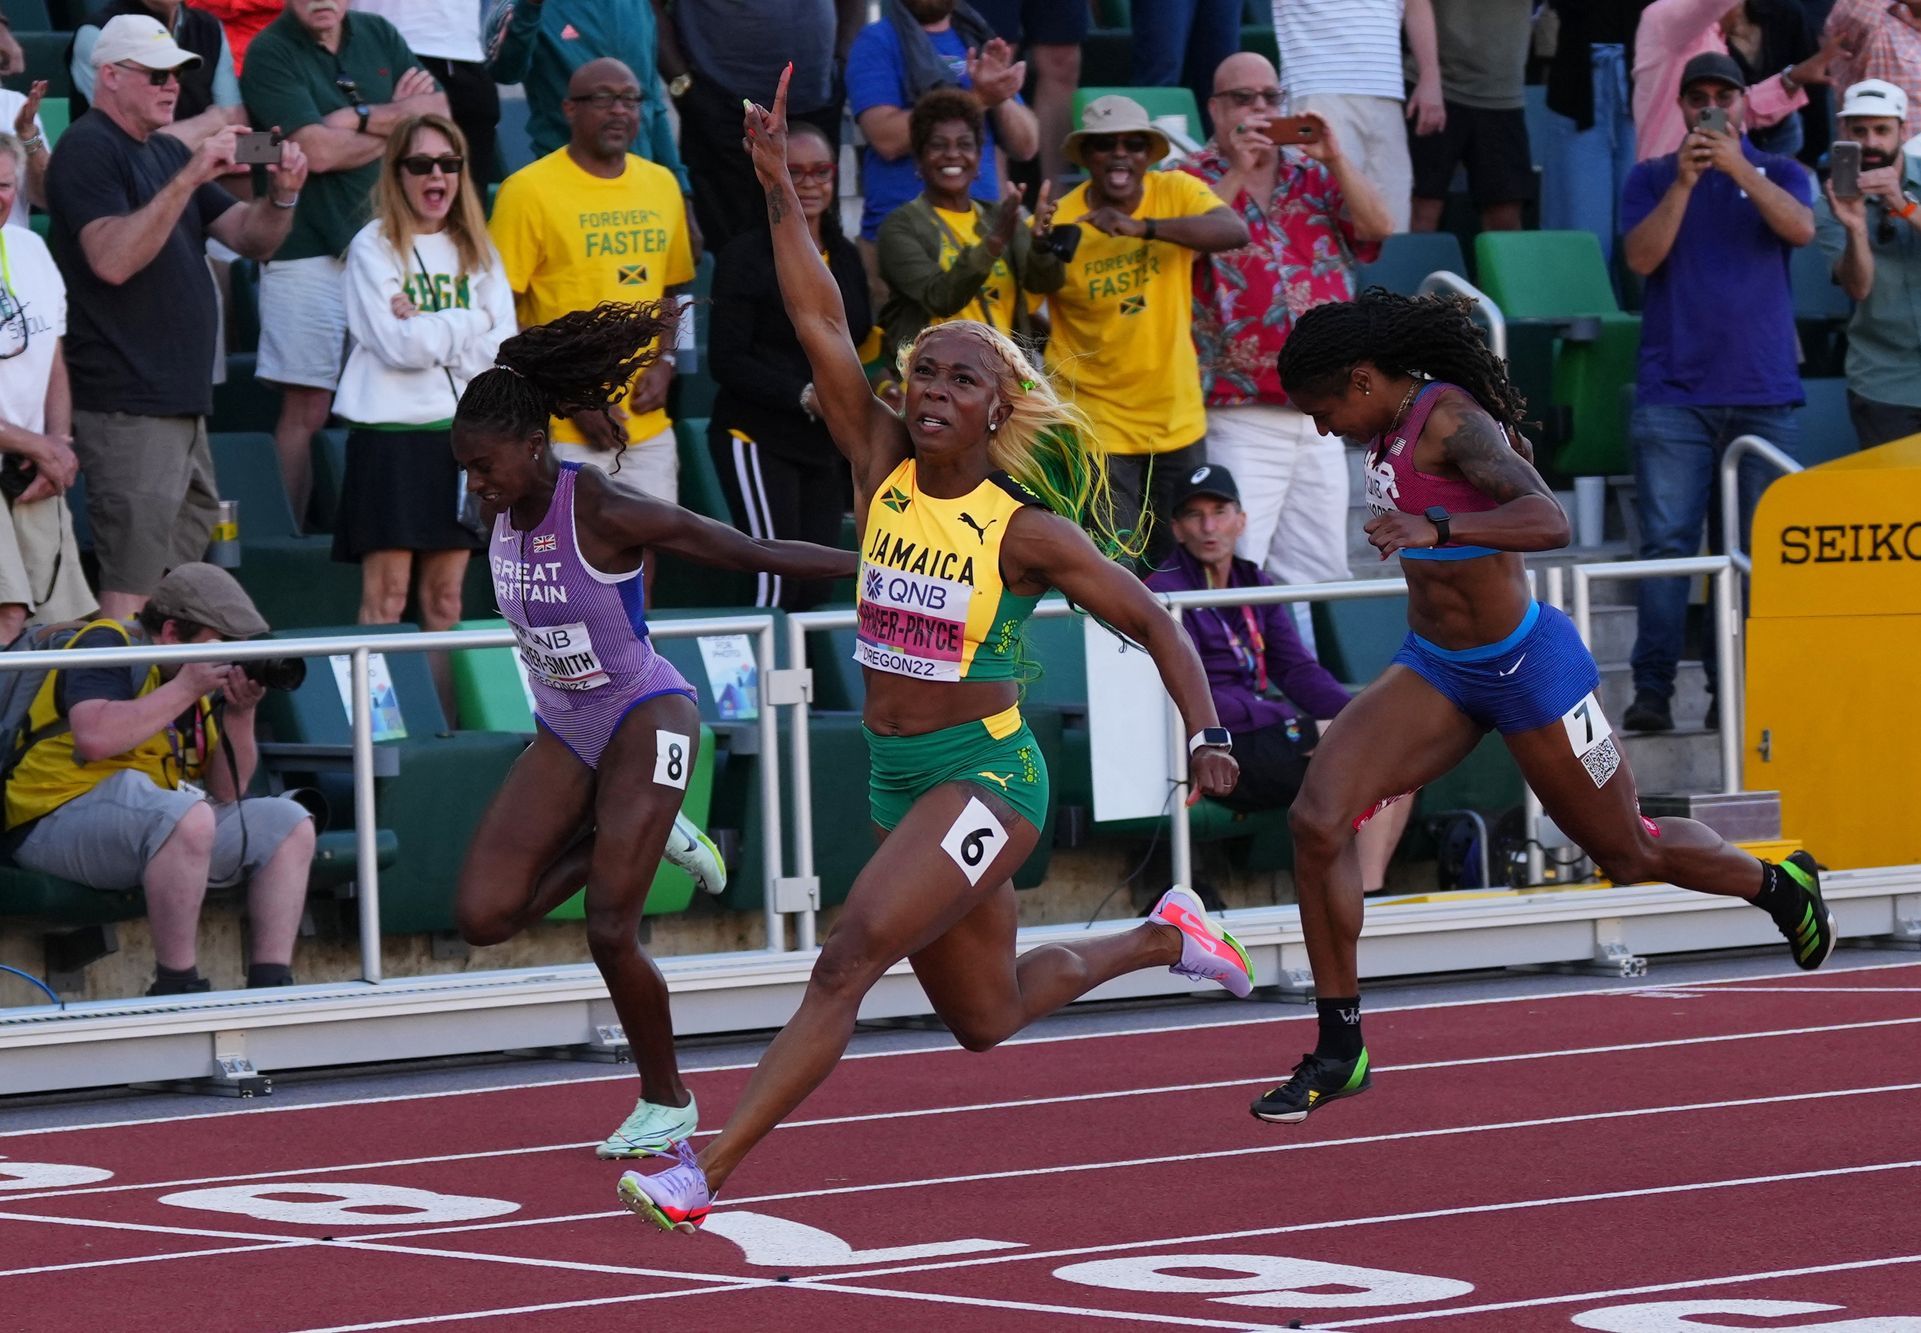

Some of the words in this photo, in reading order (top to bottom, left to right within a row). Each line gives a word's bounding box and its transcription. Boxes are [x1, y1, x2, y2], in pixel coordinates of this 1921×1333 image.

[579, 209, 649, 229] FOREVER
[585, 229, 667, 257] FASTER
[493, 555, 562, 581] GREAT
[868, 528, 975, 588] JAMAICA
[494, 580, 567, 603] RITAIN
[889, 578, 947, 610] QNB
[1573, 701, 1594, 744] 7
[667, 743, 683, 781] 8
[961, 828, 994, 866] 6
[157, 1182, 522, 1225] 8
